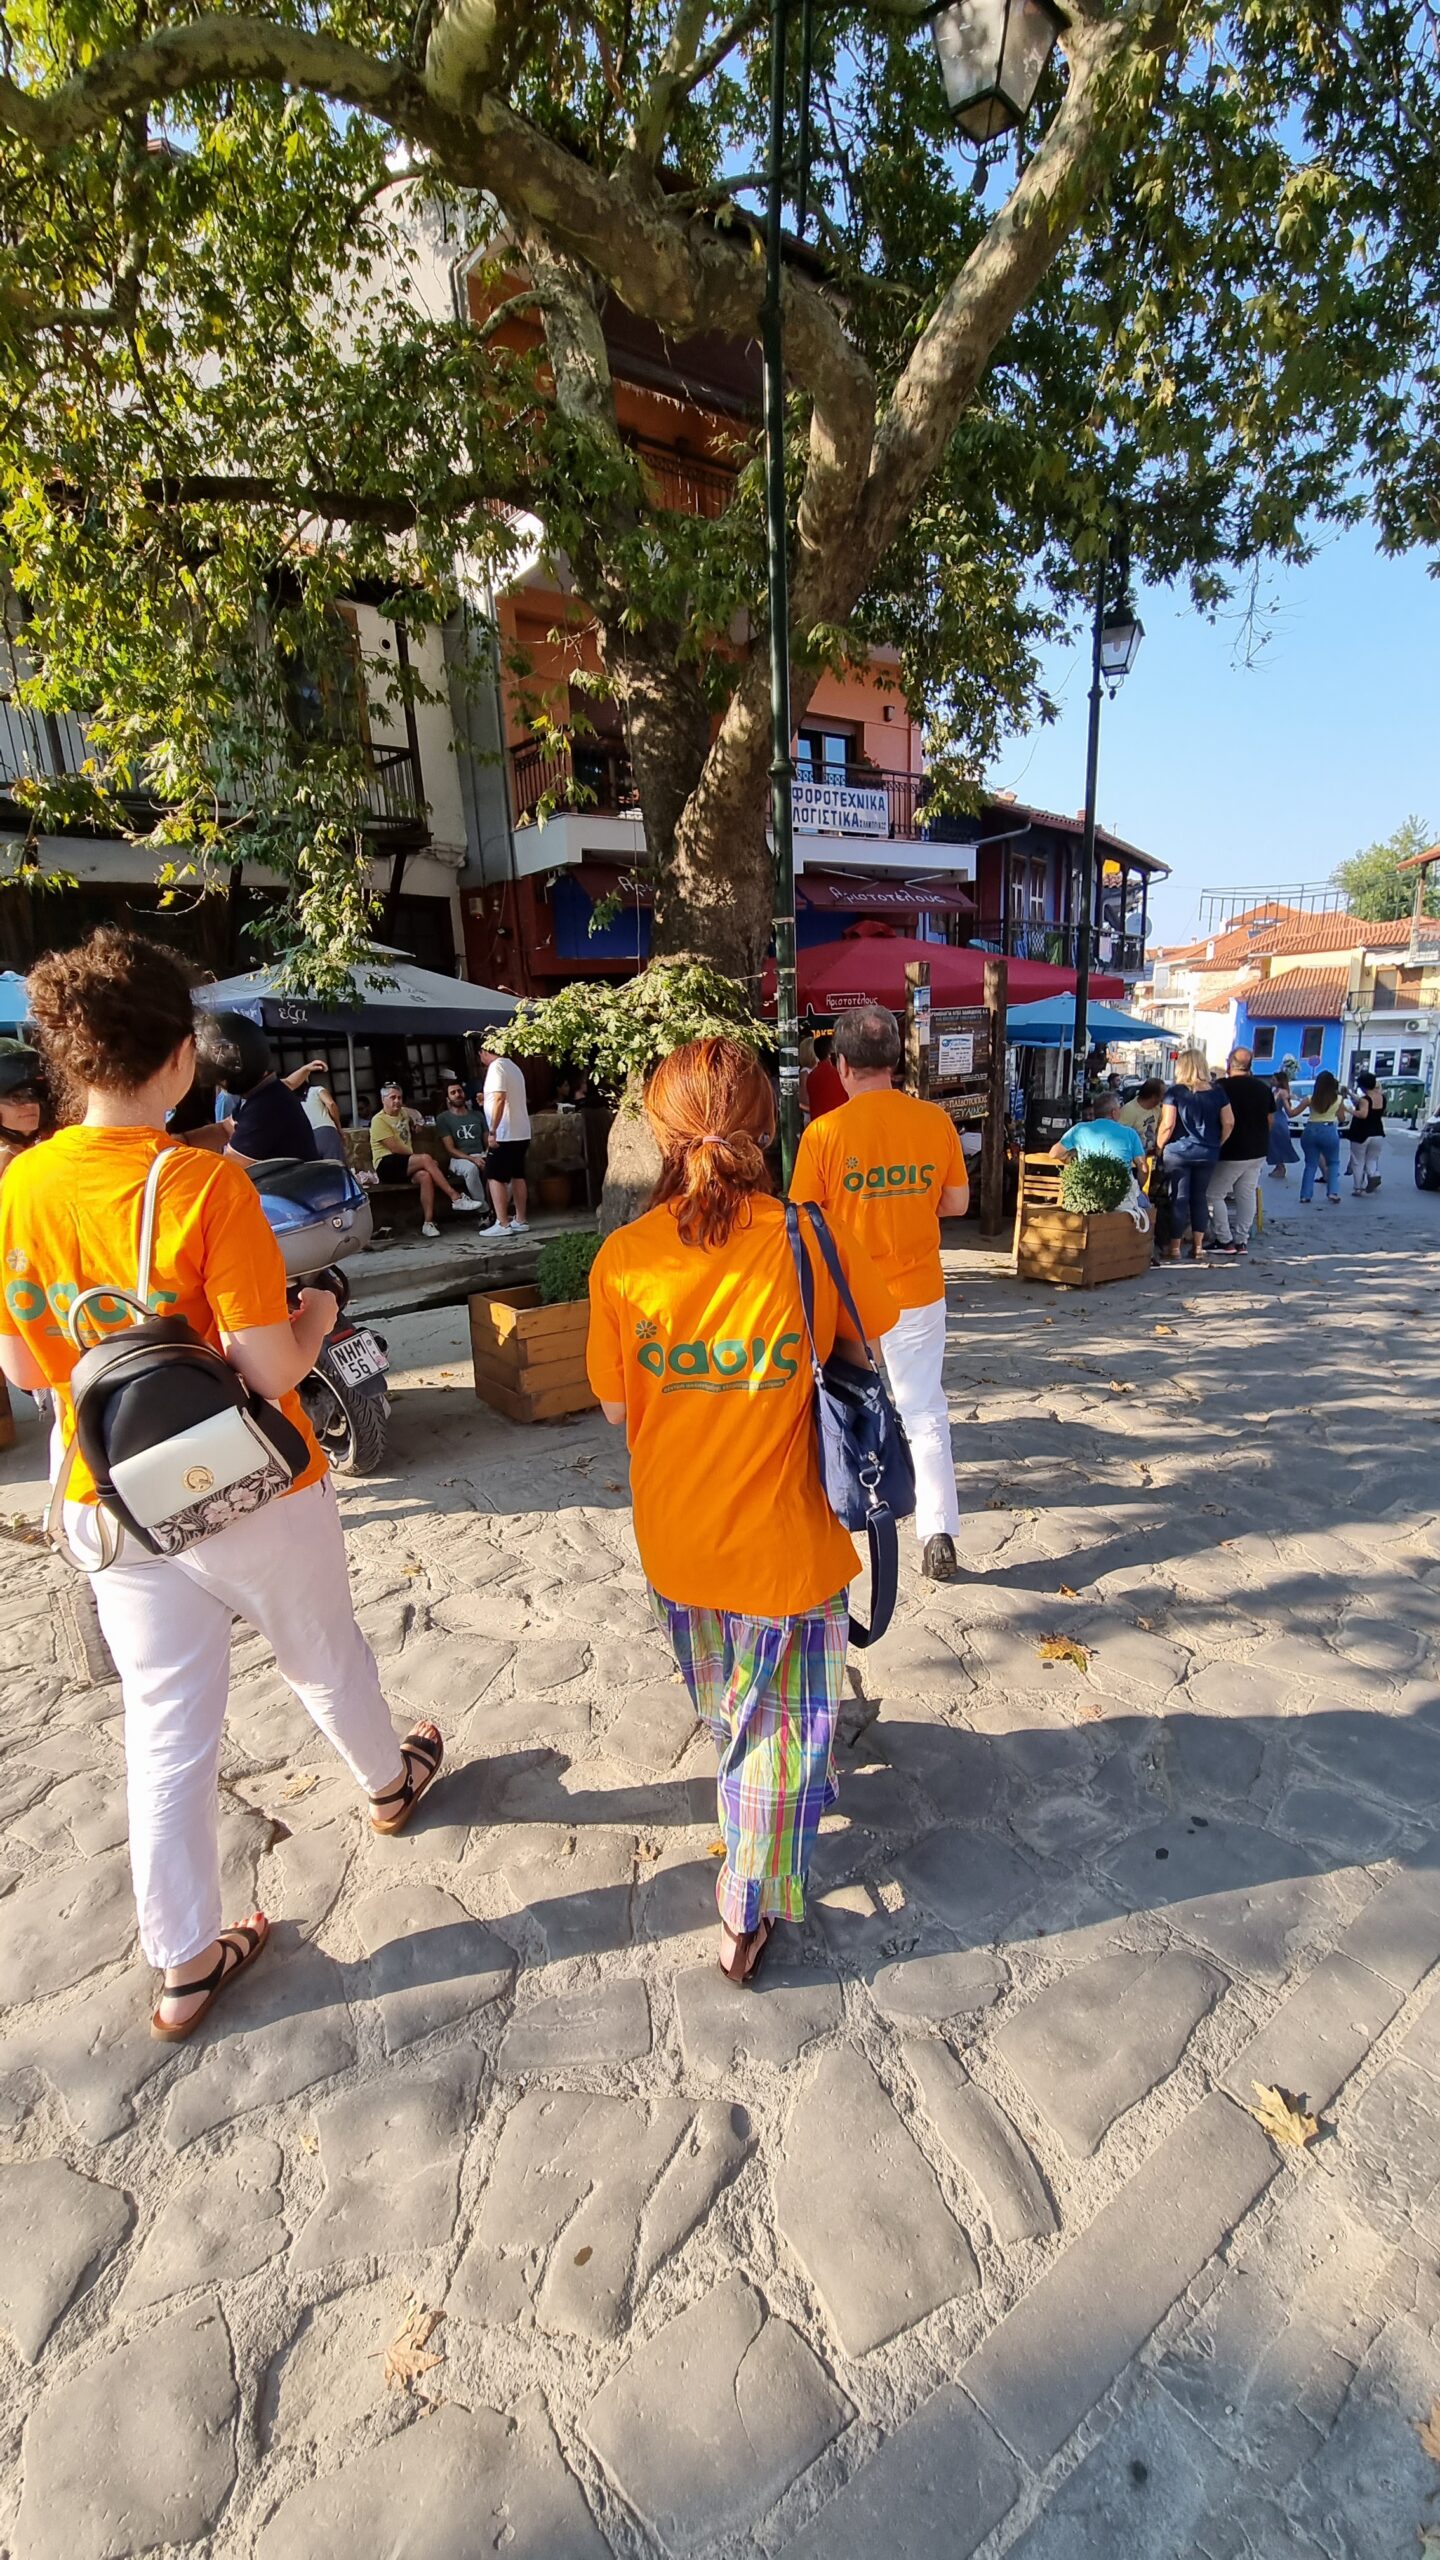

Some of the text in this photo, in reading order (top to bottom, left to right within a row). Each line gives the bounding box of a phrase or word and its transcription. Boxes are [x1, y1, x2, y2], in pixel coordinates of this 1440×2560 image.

[792, 787, 886, 812] ΦΟΡΟΤΕΧΝΙΚΑ
[792, 806, 859, 828] ΛΟΓΙΣΤΙΚΑ
[333, 1339, 367, 1366] NHM
[348, 1358, 372, 1379] 56
